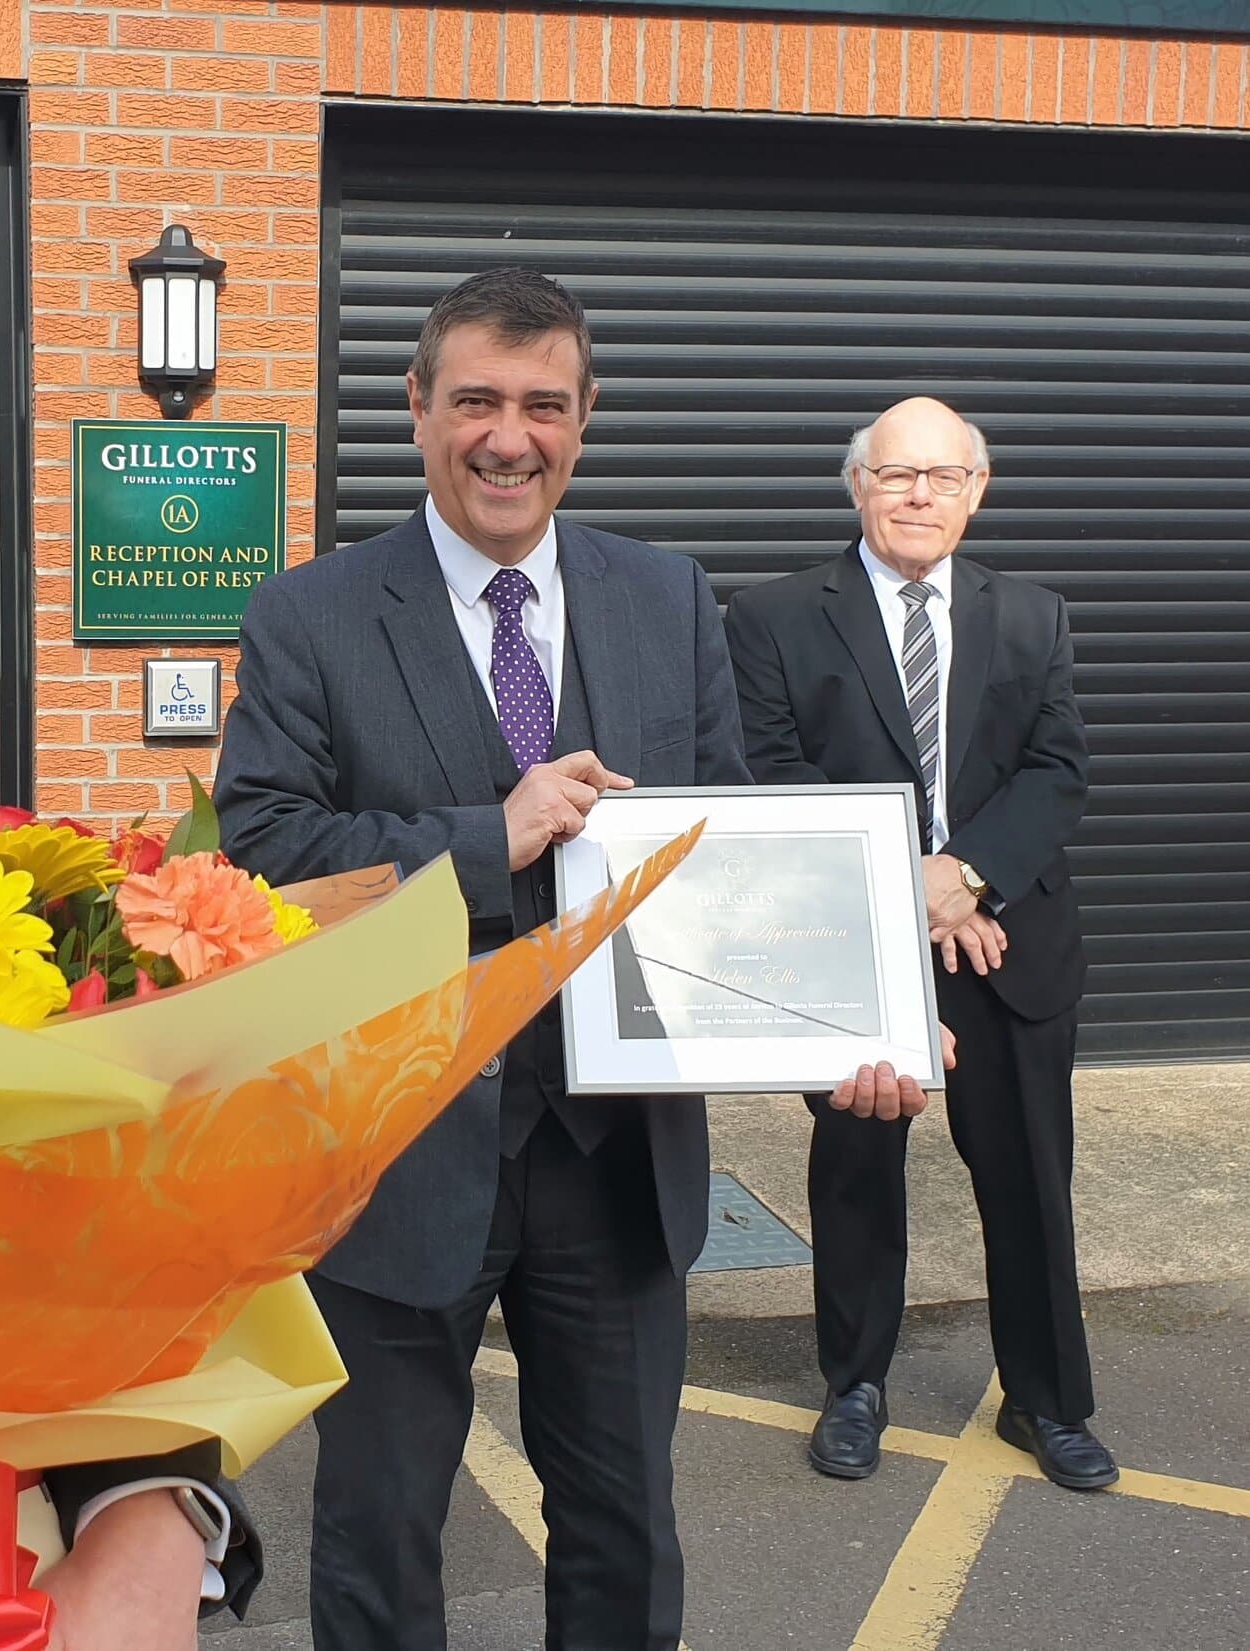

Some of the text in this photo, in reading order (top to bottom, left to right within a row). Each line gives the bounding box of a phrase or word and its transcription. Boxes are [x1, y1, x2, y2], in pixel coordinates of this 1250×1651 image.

[101, 443, 257, 474] GILLOTTS
[123, 476, 236, 486] FUNERAL DIRECTORS
[168, 504, 191, 523] 1A
[90, 545, 269, 564] RECEPTION AND
[92, 569, 266, 588] CHAPEL OF REST
[160, 704, 206, 715] PRESS
[696, 892, 775, 906] GILLOTTS
[758, 920, 847, 945] Appreciation
